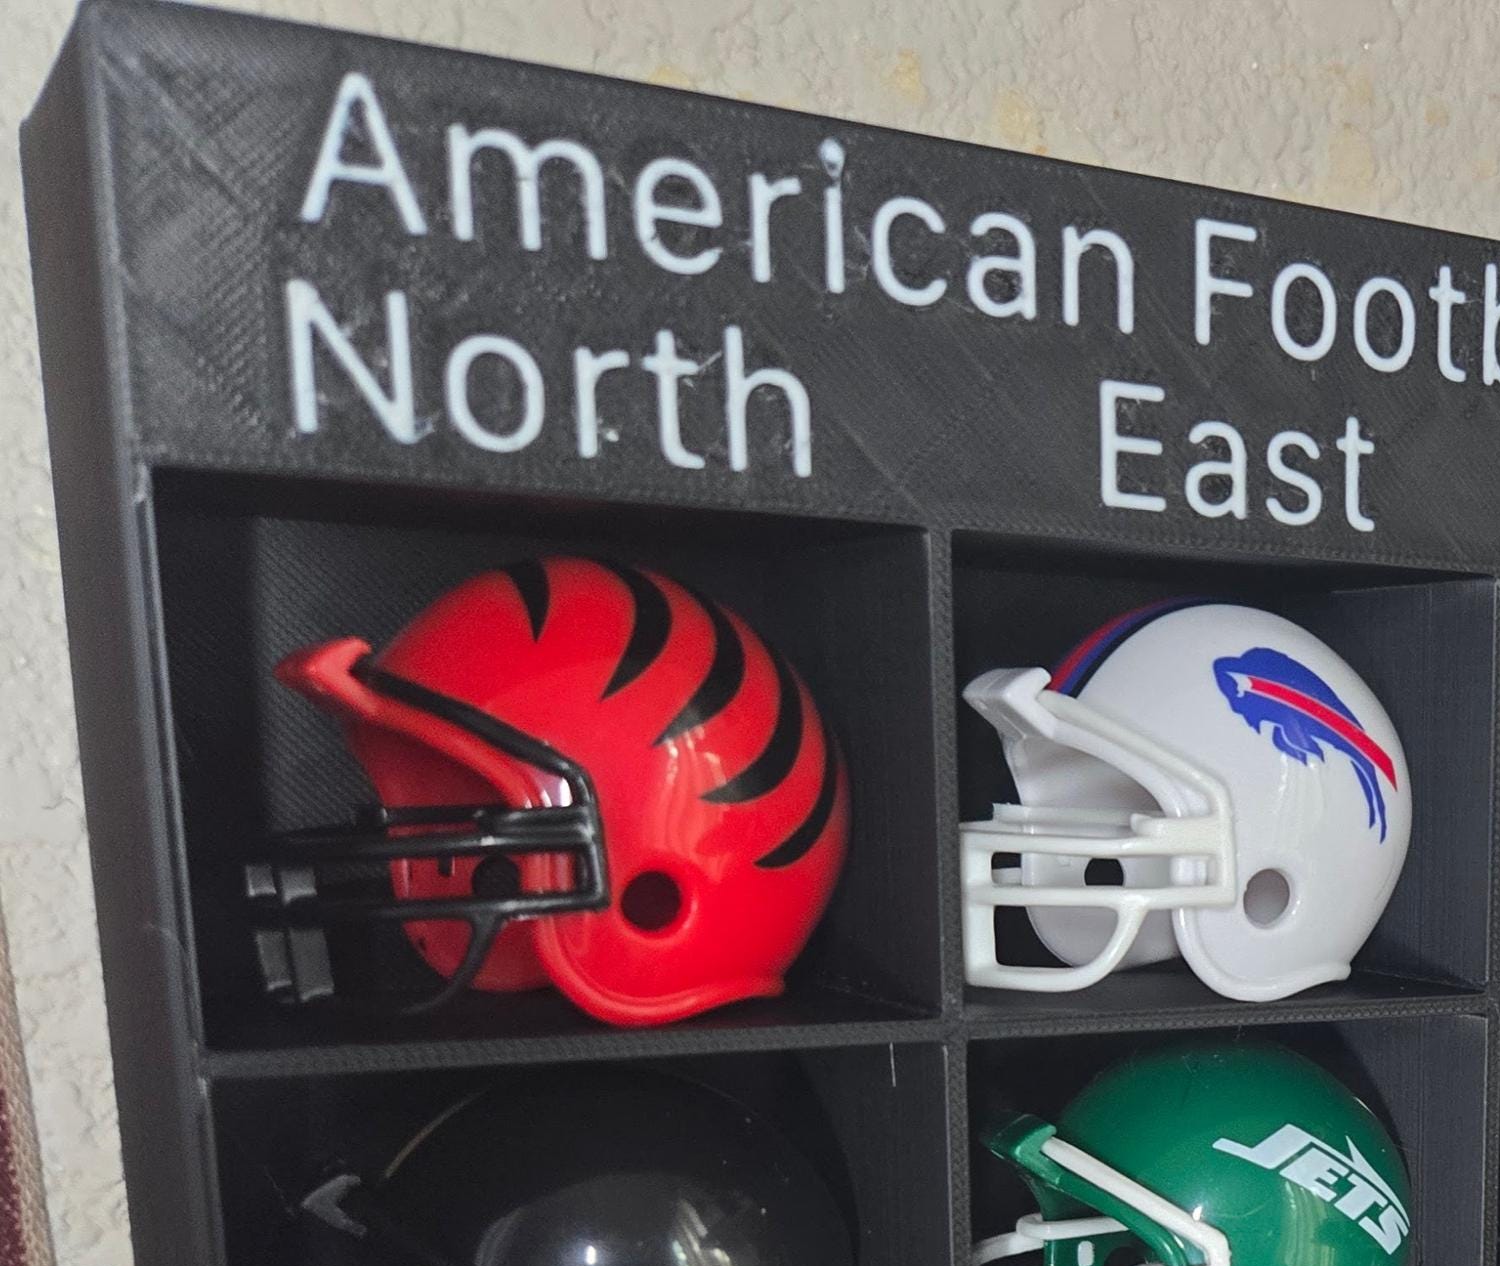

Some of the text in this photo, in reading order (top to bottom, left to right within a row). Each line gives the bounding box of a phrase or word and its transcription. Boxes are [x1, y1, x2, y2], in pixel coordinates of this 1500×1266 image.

[299, 72, 1135, 336] American
[283, 277, 813, 479] North
[1098, 378, 1376, 533] East
[1211, 1122, 1412, 1256] JETS
